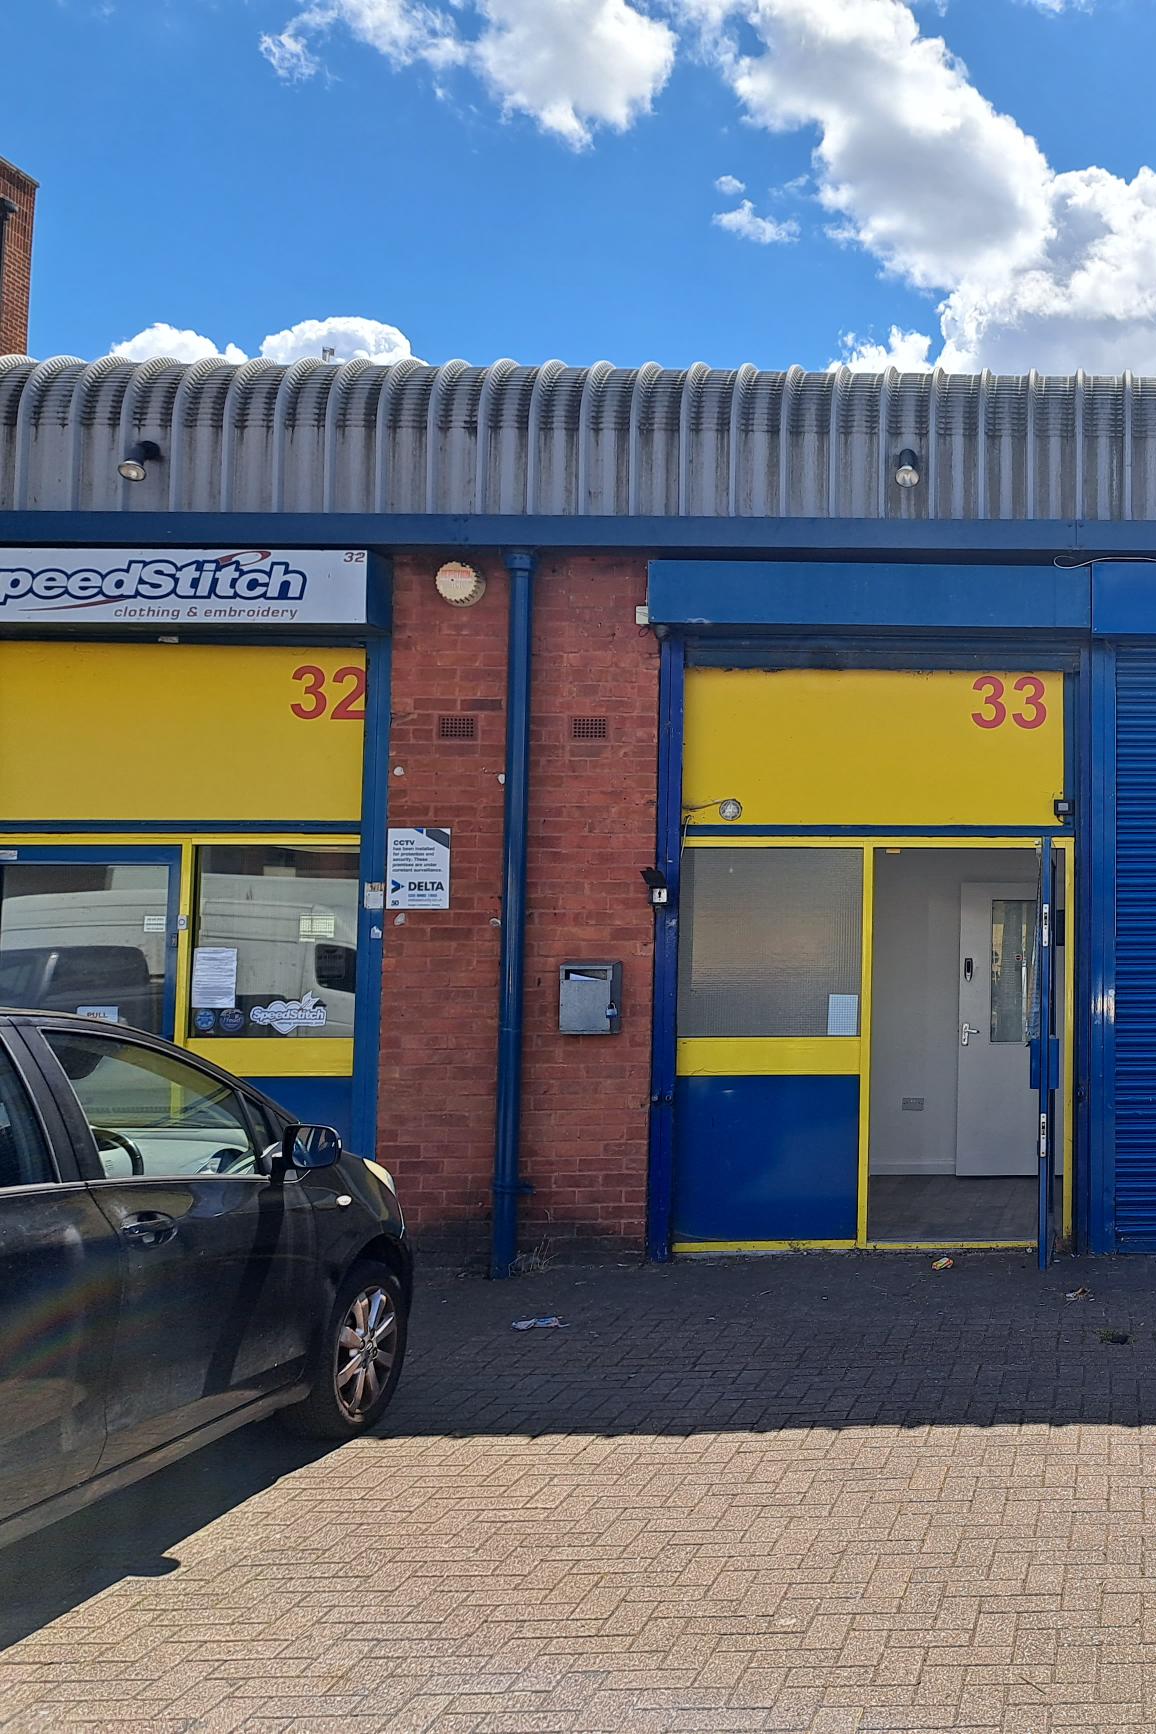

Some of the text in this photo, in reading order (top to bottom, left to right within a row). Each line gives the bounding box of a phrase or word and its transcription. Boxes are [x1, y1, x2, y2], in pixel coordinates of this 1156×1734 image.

[343, 552, 366, 563] 32
[0, 559, 307, 606] peedStitch
[114, 606, 298, 620] clothing & embroidery
[290, 665, 366, 720] 32
[971, 675, 1047, 730] 33
[408, 881, 445, 891] DELTA
[251, 1008, 324, 1021] SpeedStitch
